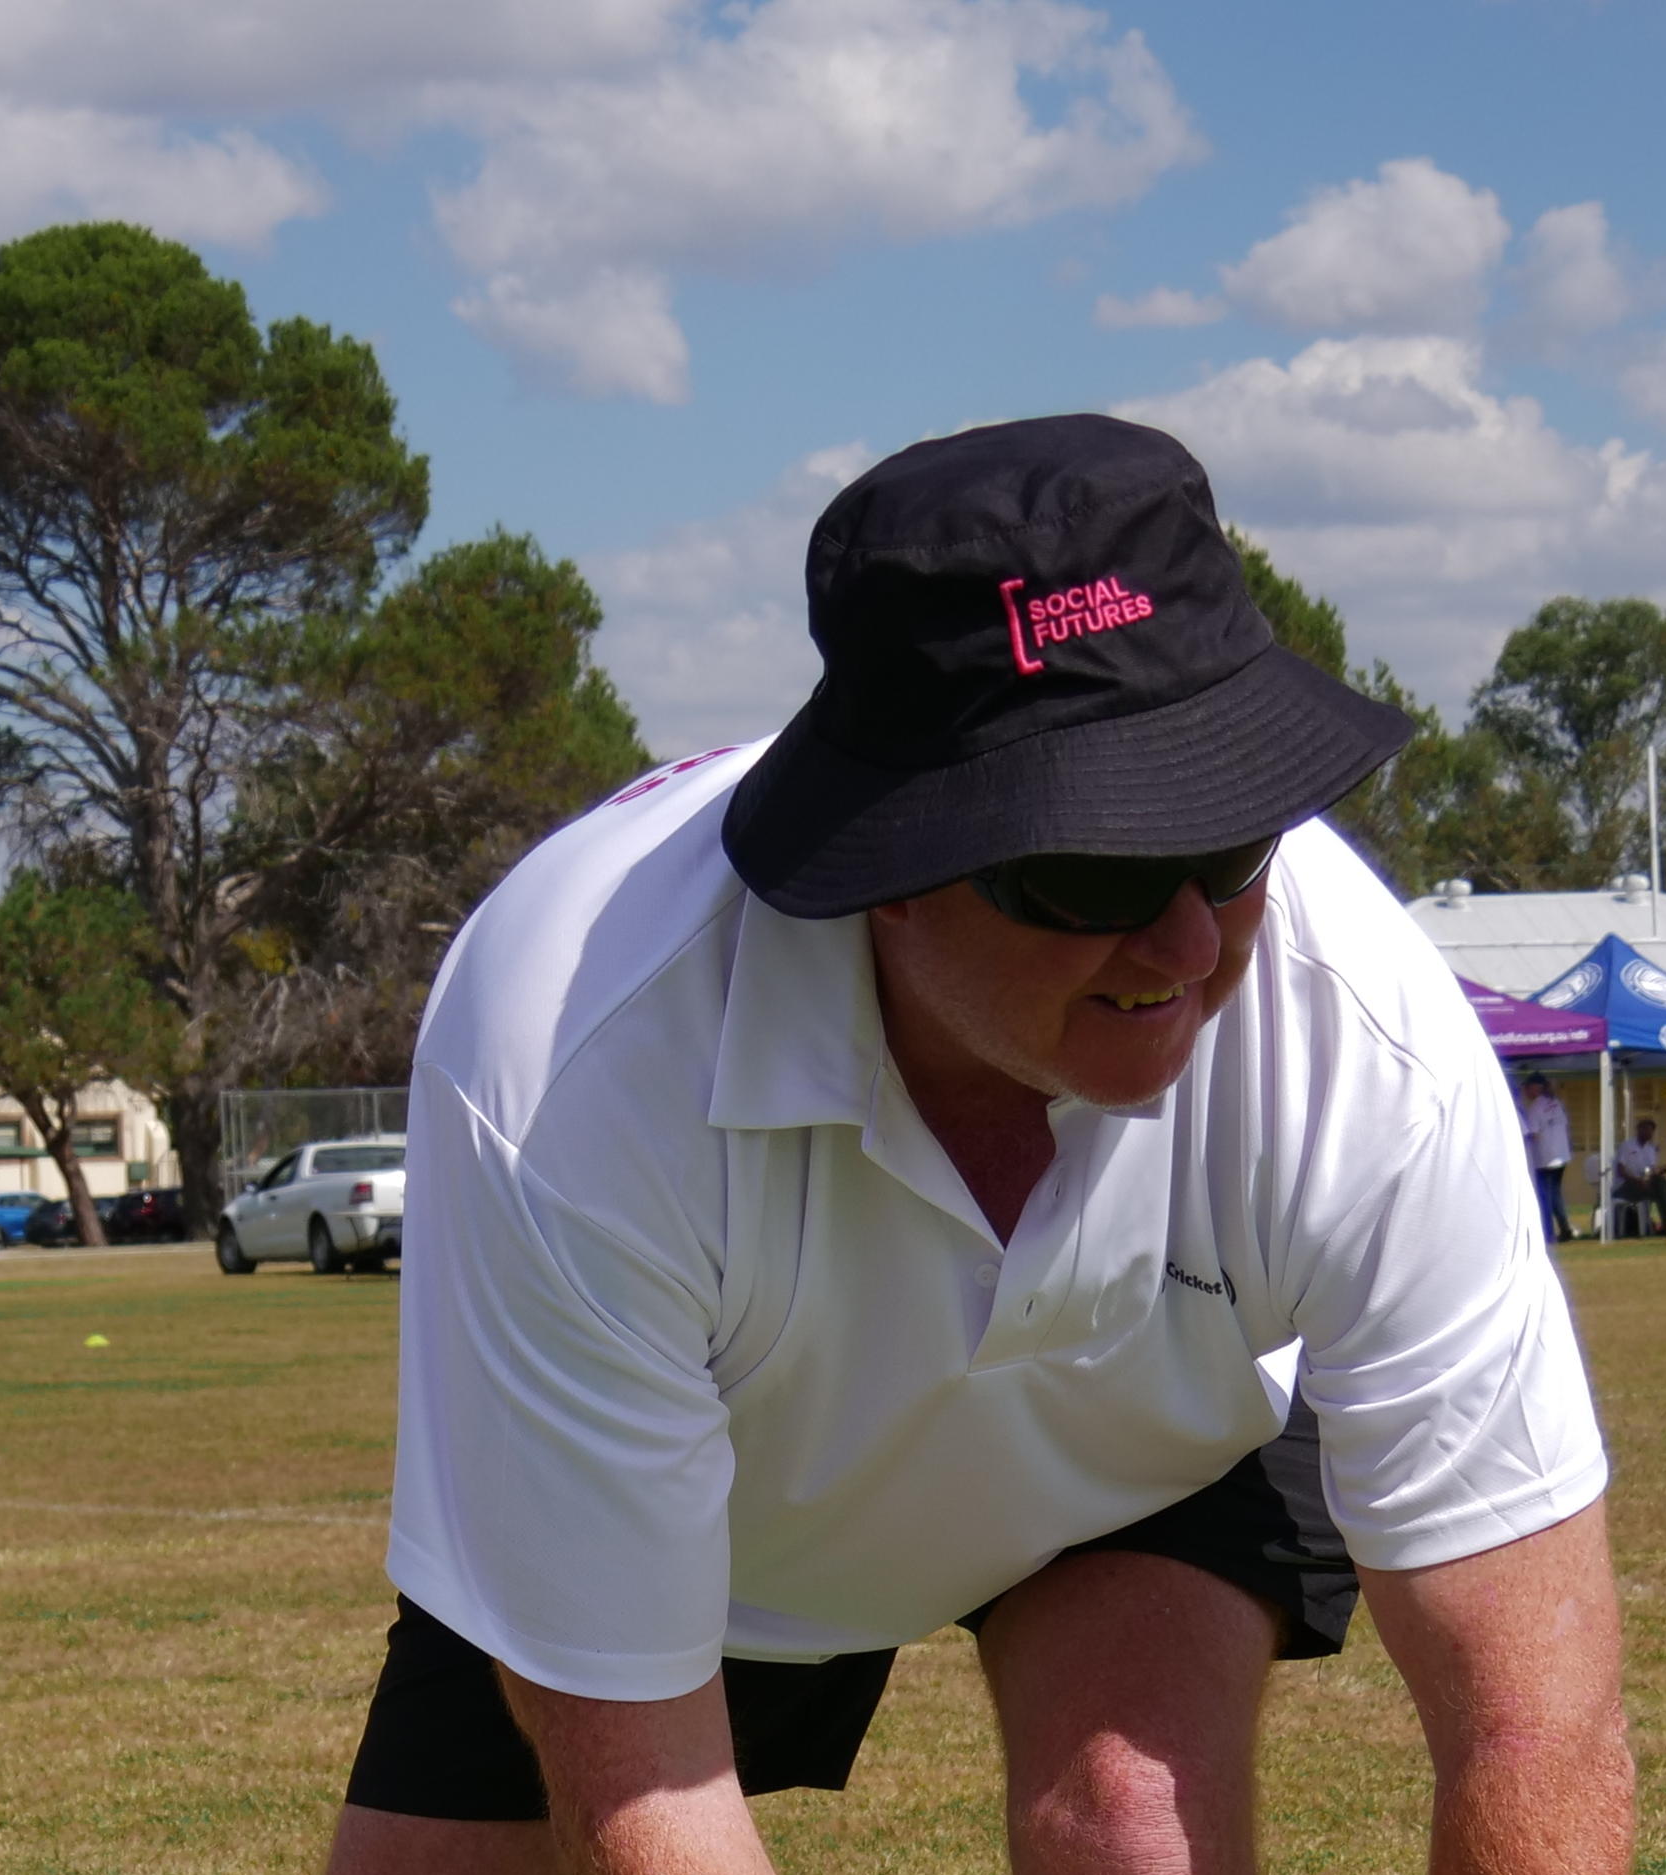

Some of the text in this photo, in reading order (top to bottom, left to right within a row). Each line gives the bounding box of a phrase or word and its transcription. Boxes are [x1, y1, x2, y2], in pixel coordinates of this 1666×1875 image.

[1028, 576, 1130, 622] SOCIAL
[1032, 595, 1154, 649] FUTURES
[1165, 1261, 1224, 1295] Cricket
